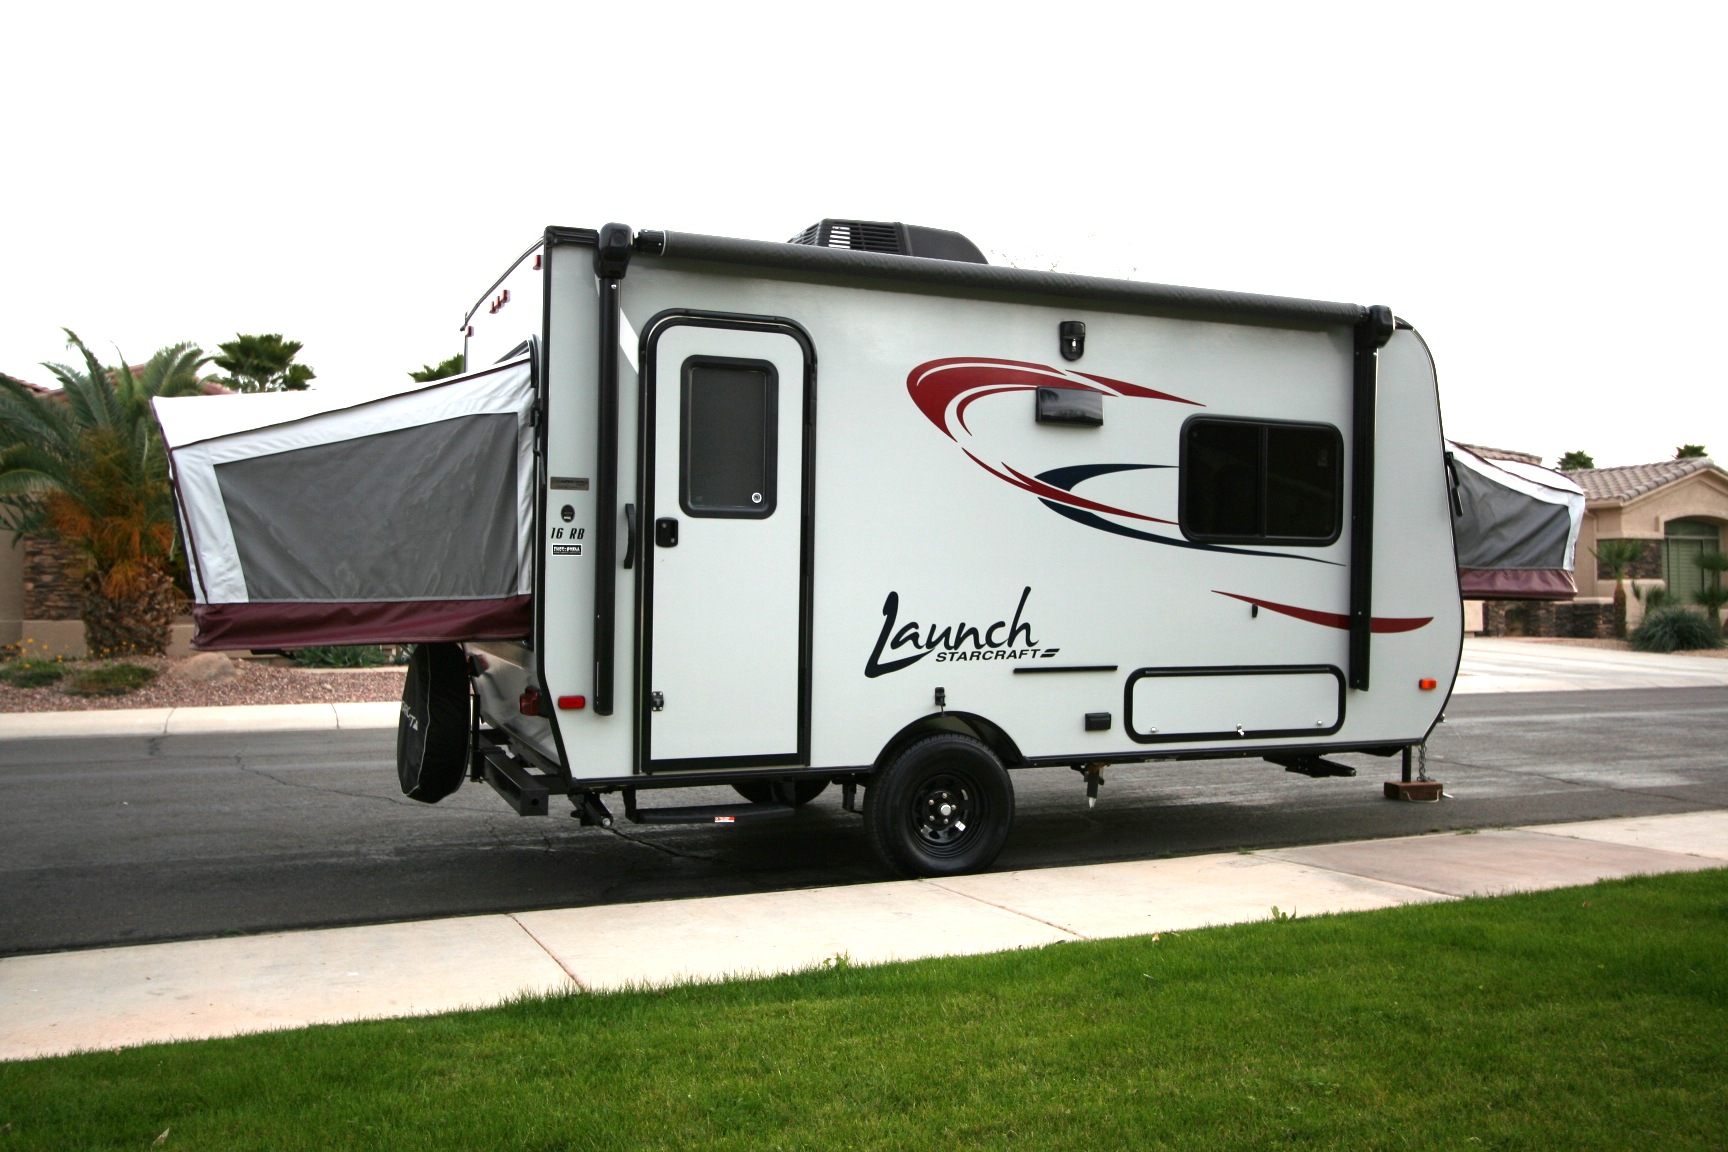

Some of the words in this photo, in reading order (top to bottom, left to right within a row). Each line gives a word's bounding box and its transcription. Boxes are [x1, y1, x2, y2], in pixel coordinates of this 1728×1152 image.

[551, 527, 564, 539] 16
[569, 527, 585, 540] RB
[864, 586, 1040, 679] Launch
[935, 648, 1041, 663] STARCRAFT
